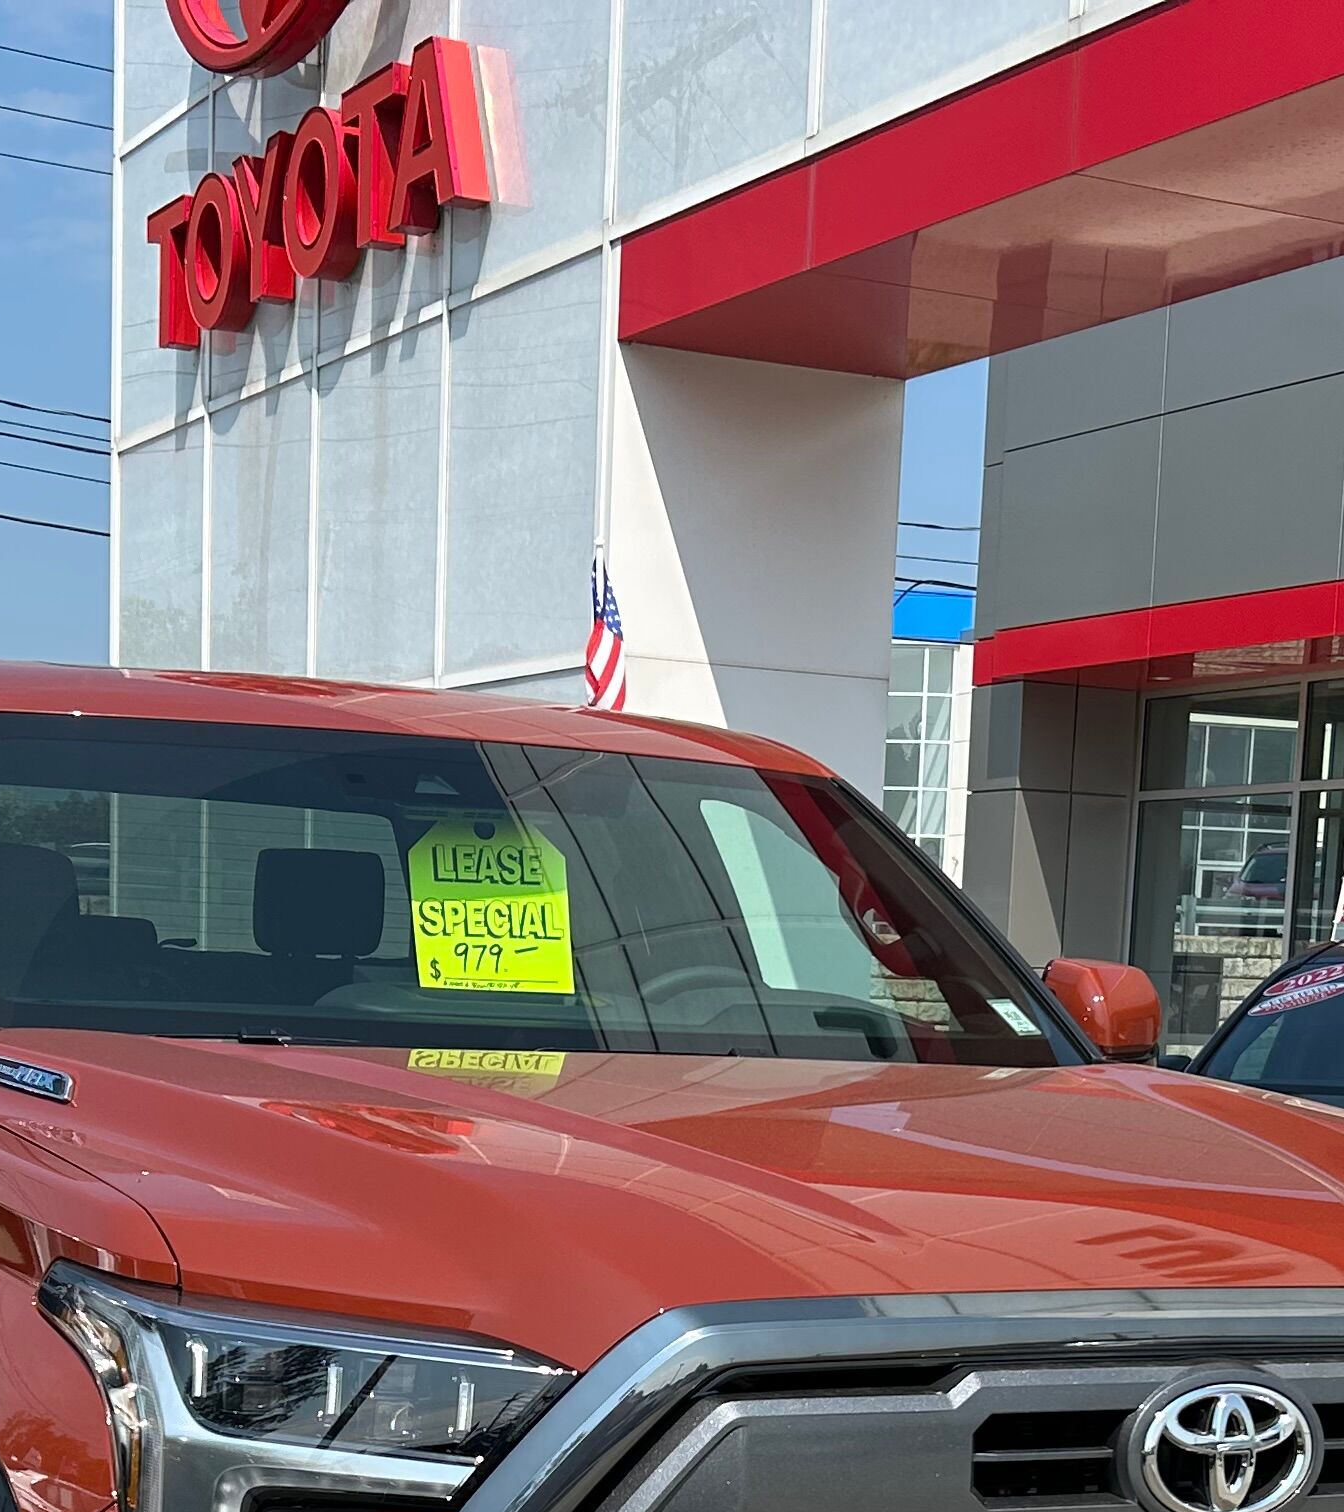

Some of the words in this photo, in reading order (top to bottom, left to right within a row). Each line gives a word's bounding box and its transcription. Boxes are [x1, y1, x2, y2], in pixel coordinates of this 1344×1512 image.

[147, 36, 489, 349] TOYOTA
[432, 844, 544, 886] LEASE
[419, 898, 564, 939] SPECIAL
[1284, 966, 1344, 990] 2022
